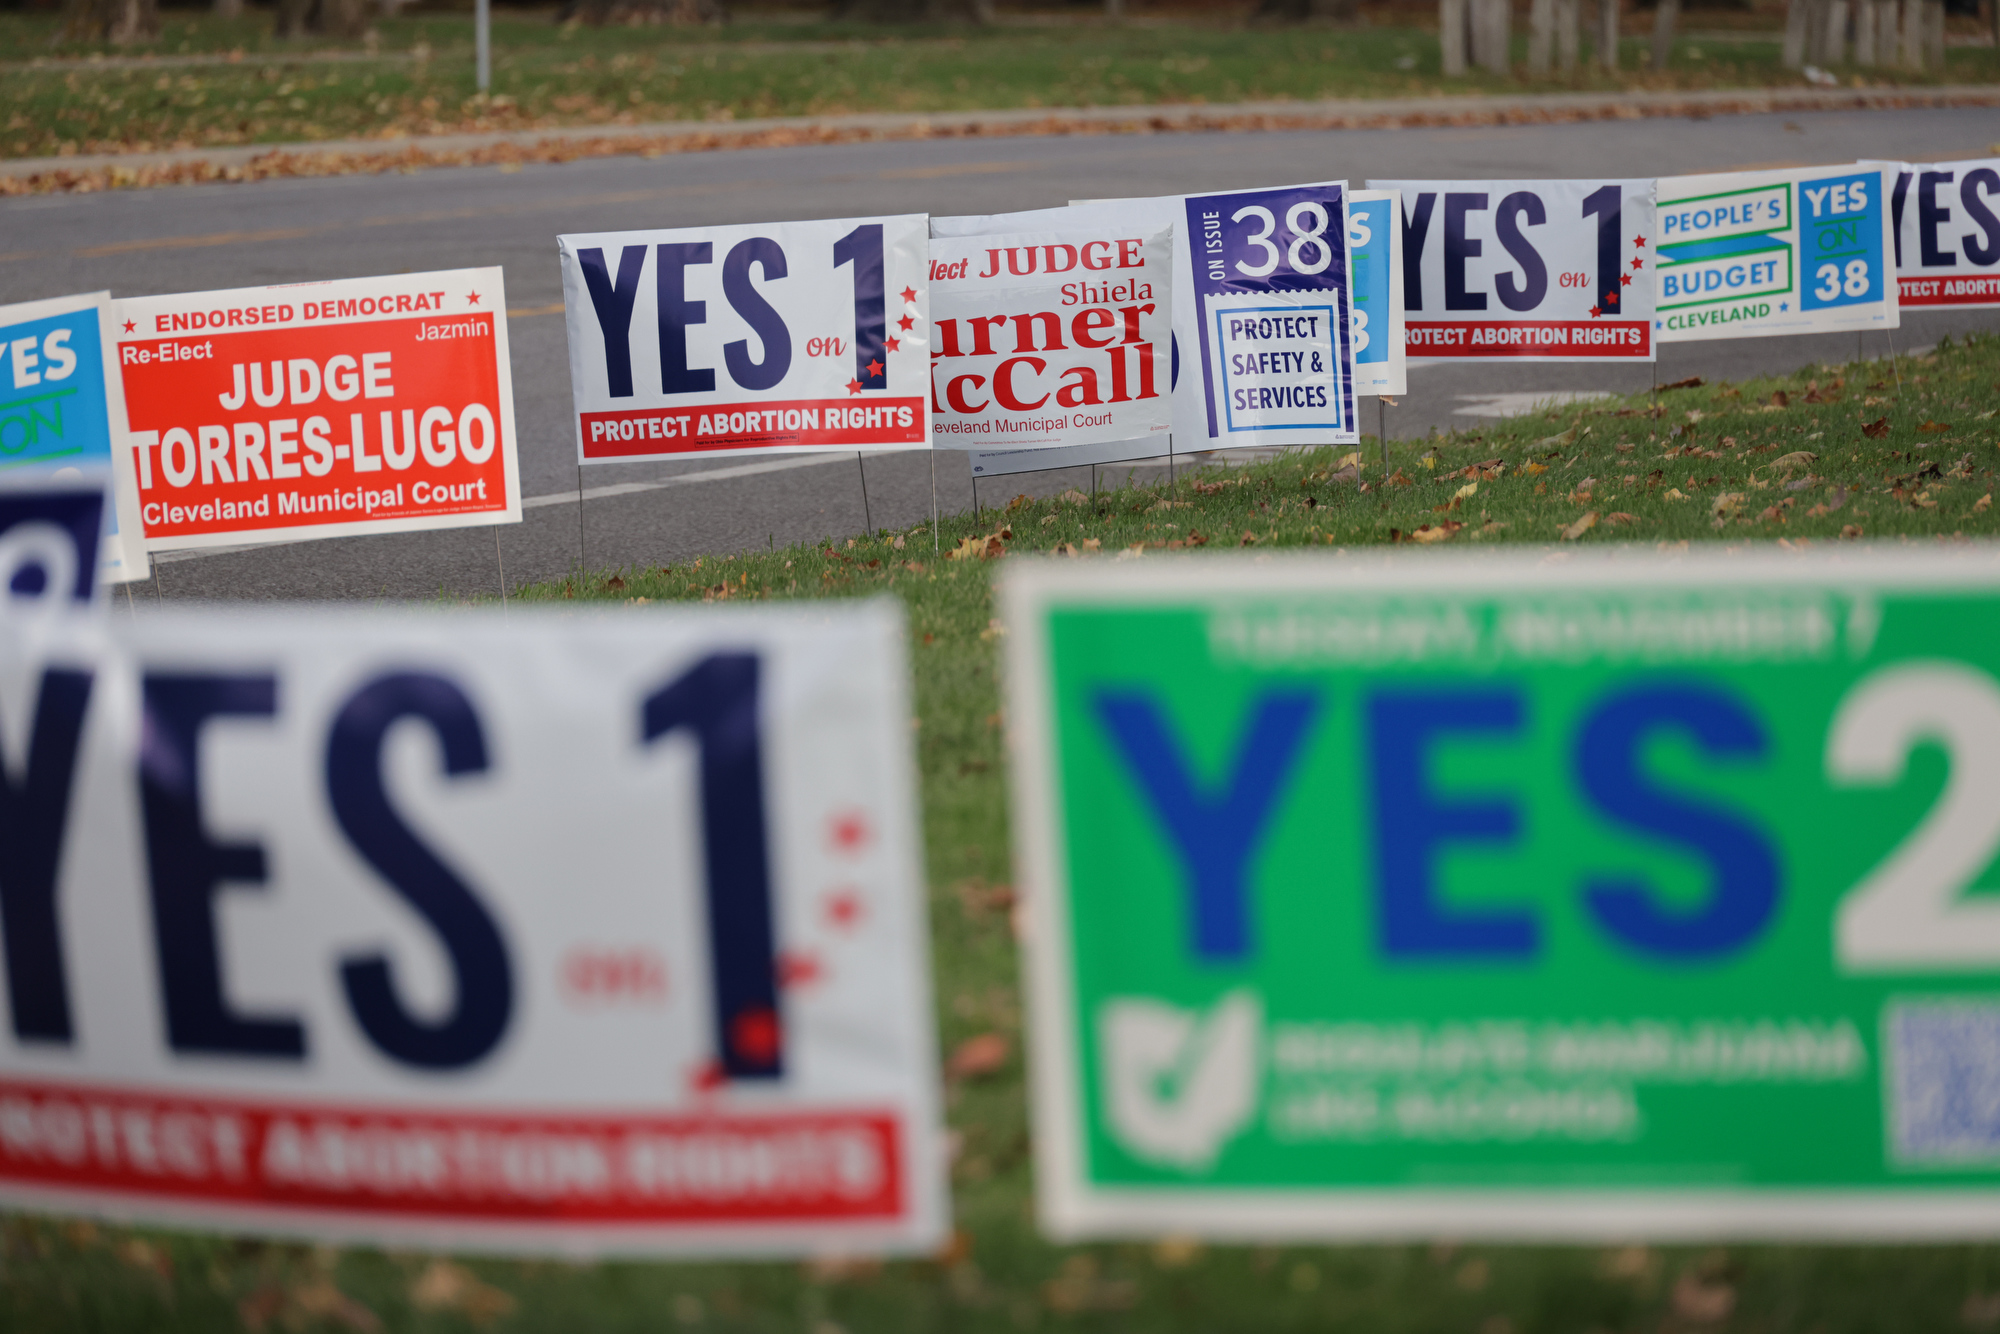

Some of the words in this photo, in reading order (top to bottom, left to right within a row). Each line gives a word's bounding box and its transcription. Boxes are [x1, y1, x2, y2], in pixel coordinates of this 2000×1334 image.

[1664, 199, 1781, 235] PEOPLE'S
[1804, 181, 1868, 217] YES
[1203, 211, 1223, 254] ISSUE
[1231, 201, 1332, 277] 38
[1400, 191, 1548, 312] YES
[1559, 271, 1591, 288] on
[1581, 185, 1622, 315] 1
[1818, 222, 1857, 251] ON
[929, 258, 968, 281] lect
[979, 239, 1145, 278] JUDGE
[1209, 260, 1225, 281] ON
[1663, 260, 1778, 298] BUDGET
[1061, 278, 1154, 306] Shiela
[1814, 259, 1870, 301] 38
[1897, 281, 1940, 297] TECT
[1944, 279, 2000, 296] ABORTI
[155, 304, 294, 332] ENDORSED
[303, 291, 446, 321] DEMOCRAT
[415, 318, 488, 341] Jazmin
[576, 237, 793, 398] YES
[806, 336, 847, 357] on
[833, 223, 887, 390] 1
[1230, 316, 1318, 341] PROTECT
[1667, 303, 1771, 330] CLEVELAND
[930, 303, 1156, 359] urner
[1405, 328, 1467, 345] OTECT
[1471, 328, 1568, 345] ABORTION
[1571, 328, 1642, 345] RIGHTS
[122, 340, 213, 365] Re-Elect
[1232, 351, 1304, 376] SAFETY
[1310, 351, 1324, 373] &
[218, 351, 394, 411] JUDGE
[1234, 385, 1327, 411] SERVICES
[0, 401, 63, 455] ON
[590, 415, 691, 443] PROTECT
[697, 408, 819, 436] ABORTION
[825, 406, 914, 429] RIGHTS
[932, 420, 990, 434] eveland
[995, 415, 1067, 434] Municipal
[1073, 411, 1112, 428] Court
[129, 403, 496, 490] TORRES-LUGO
[143, 494, 269, 525] Cleveland
[277, 483, 404, 514] Municipal
[411, 478, 487, 505] Court
[1092, 677, 1785, 974] YES
[1825, 658, 2000, 974] 2
[0, 662, 515, 1072] YES
[640, 650, 786, 1082] 1
[0, 1096, 248, 1180] ROTECT
